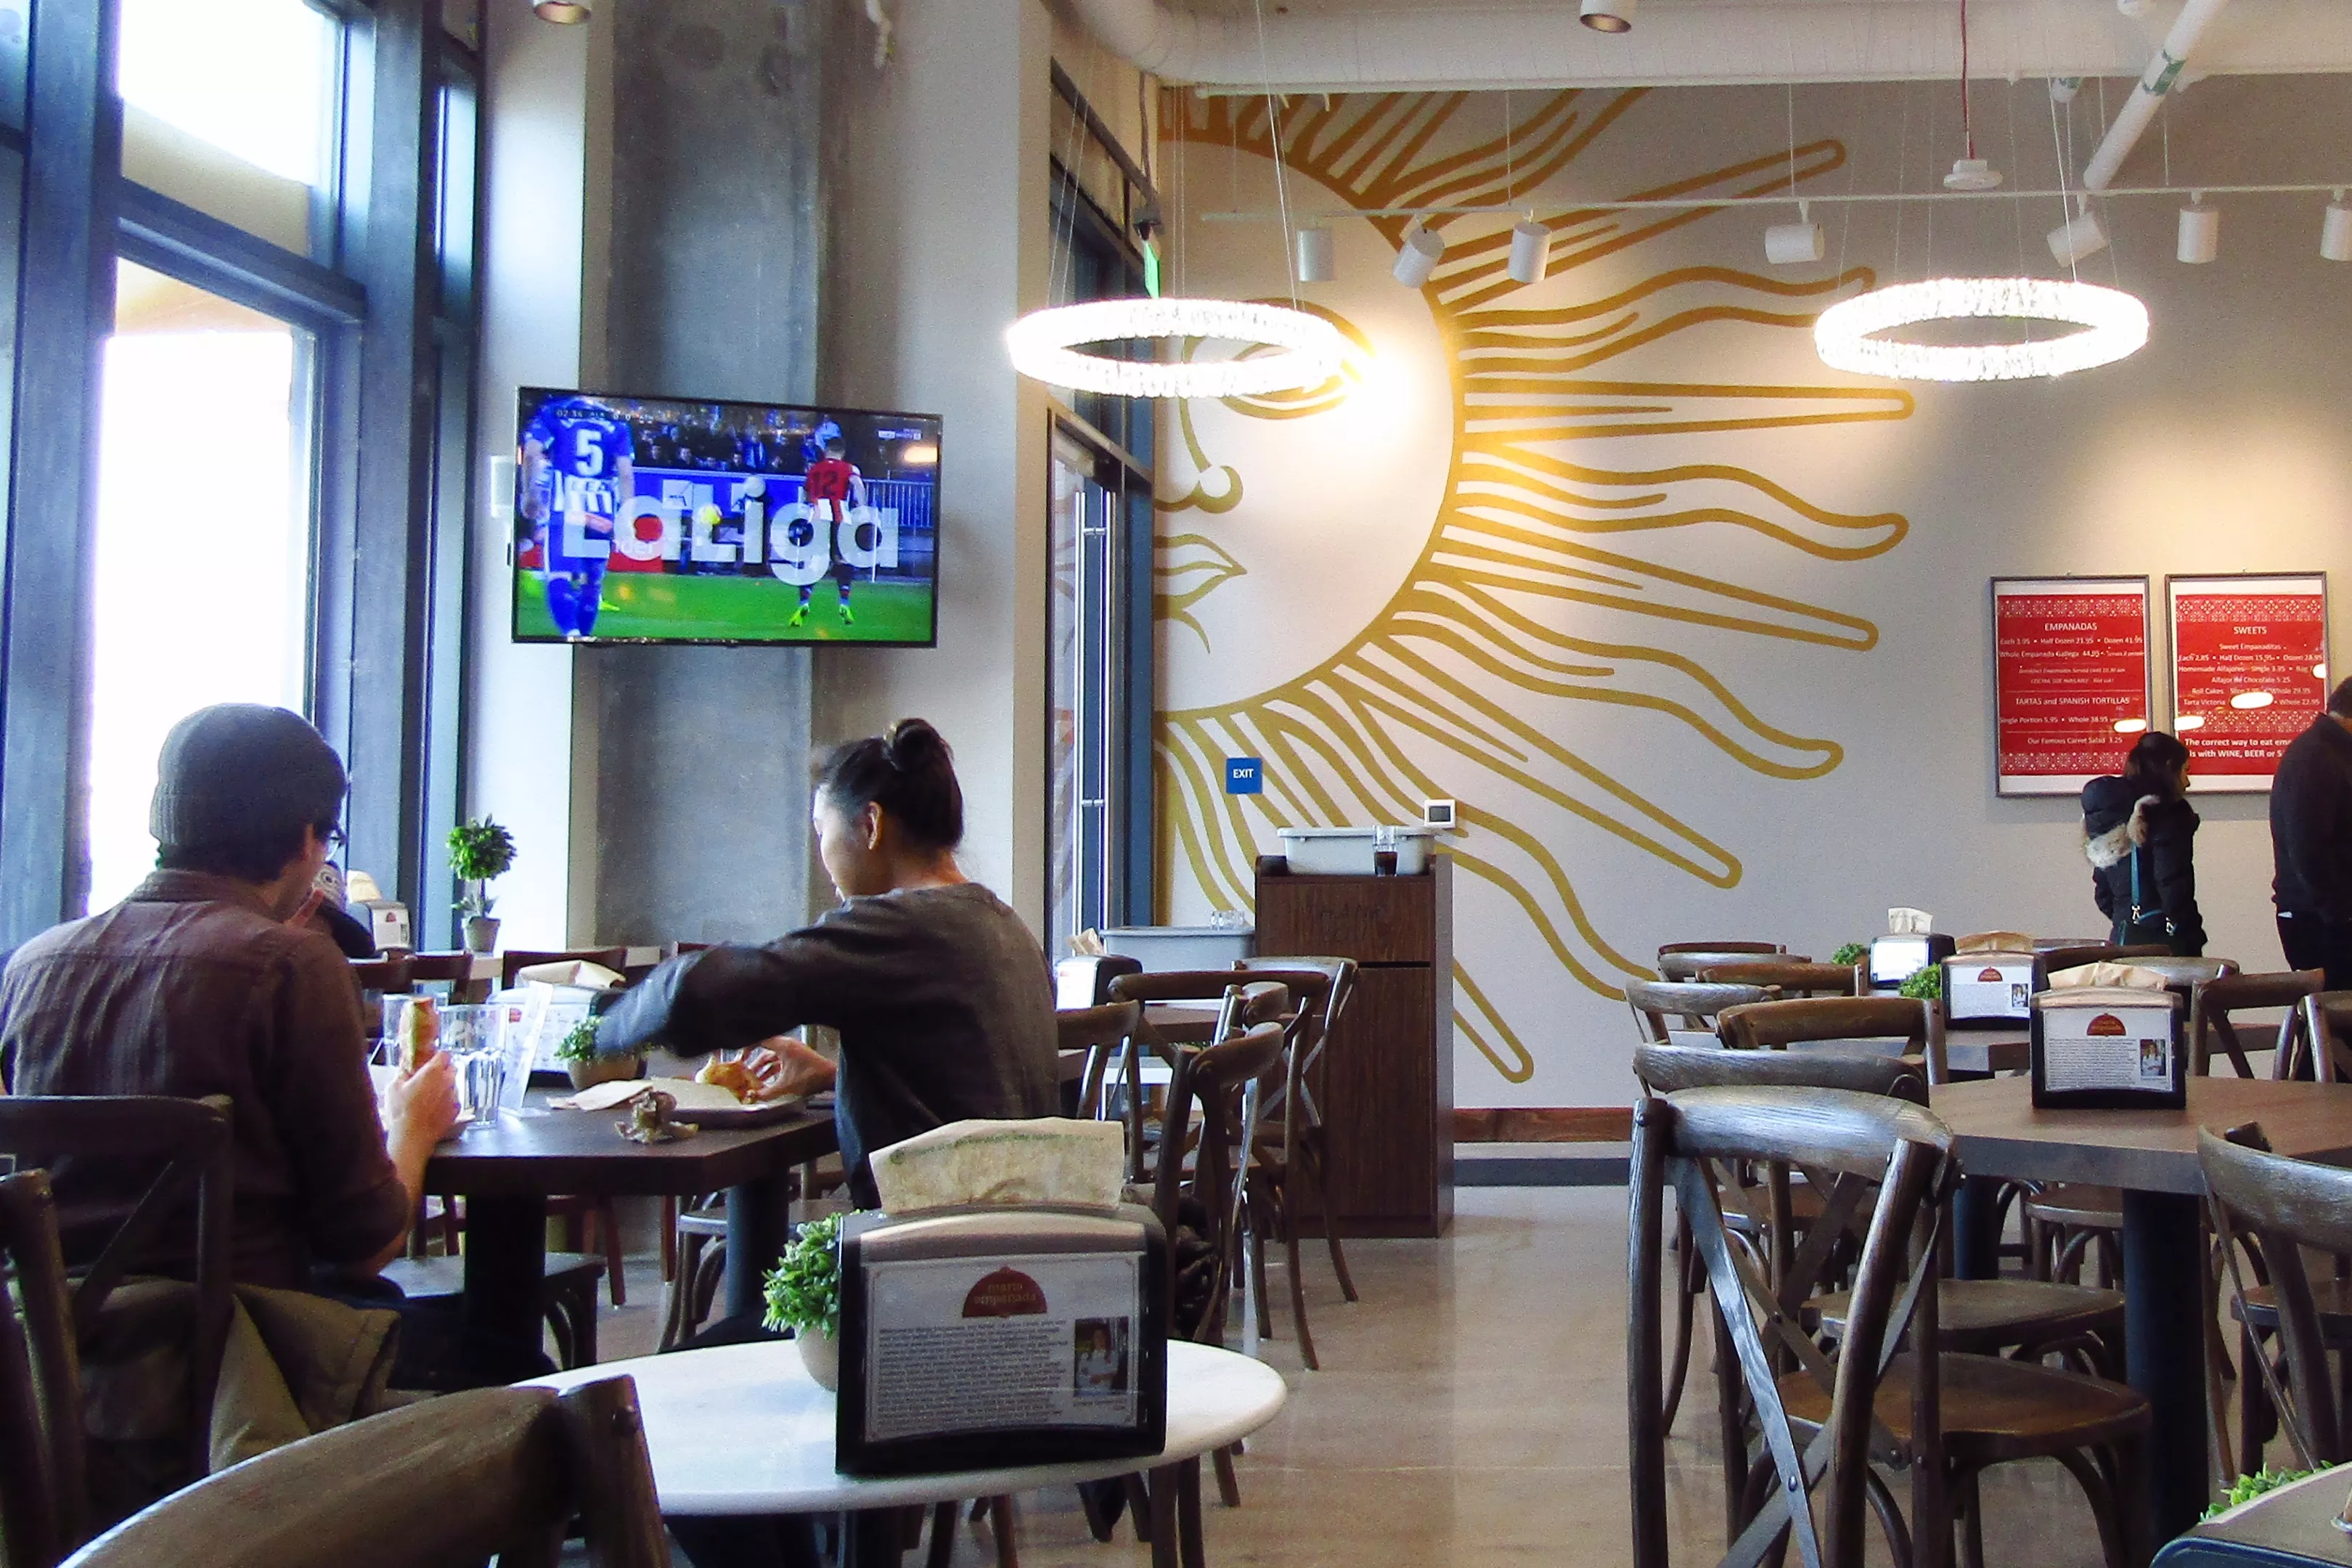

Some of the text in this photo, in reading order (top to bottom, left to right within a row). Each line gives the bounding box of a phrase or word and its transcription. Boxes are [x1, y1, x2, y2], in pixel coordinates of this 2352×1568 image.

[576, 428, 603, 476] 5
[563, 473, 899, 586] LaLiga
[2044, 622, 2097, 631] EMPANADAS
[2233, 626, 2267, 634] SWEETS
[2059, 697, 2090, 706] SPANISH
[2091, 696, 2130, 705] TORTILLAS
[2231, 739, 2248, 748] way
[2218, 750, 2243, 759] WINE,
[1233, 768, 1254, 779] EXIT
